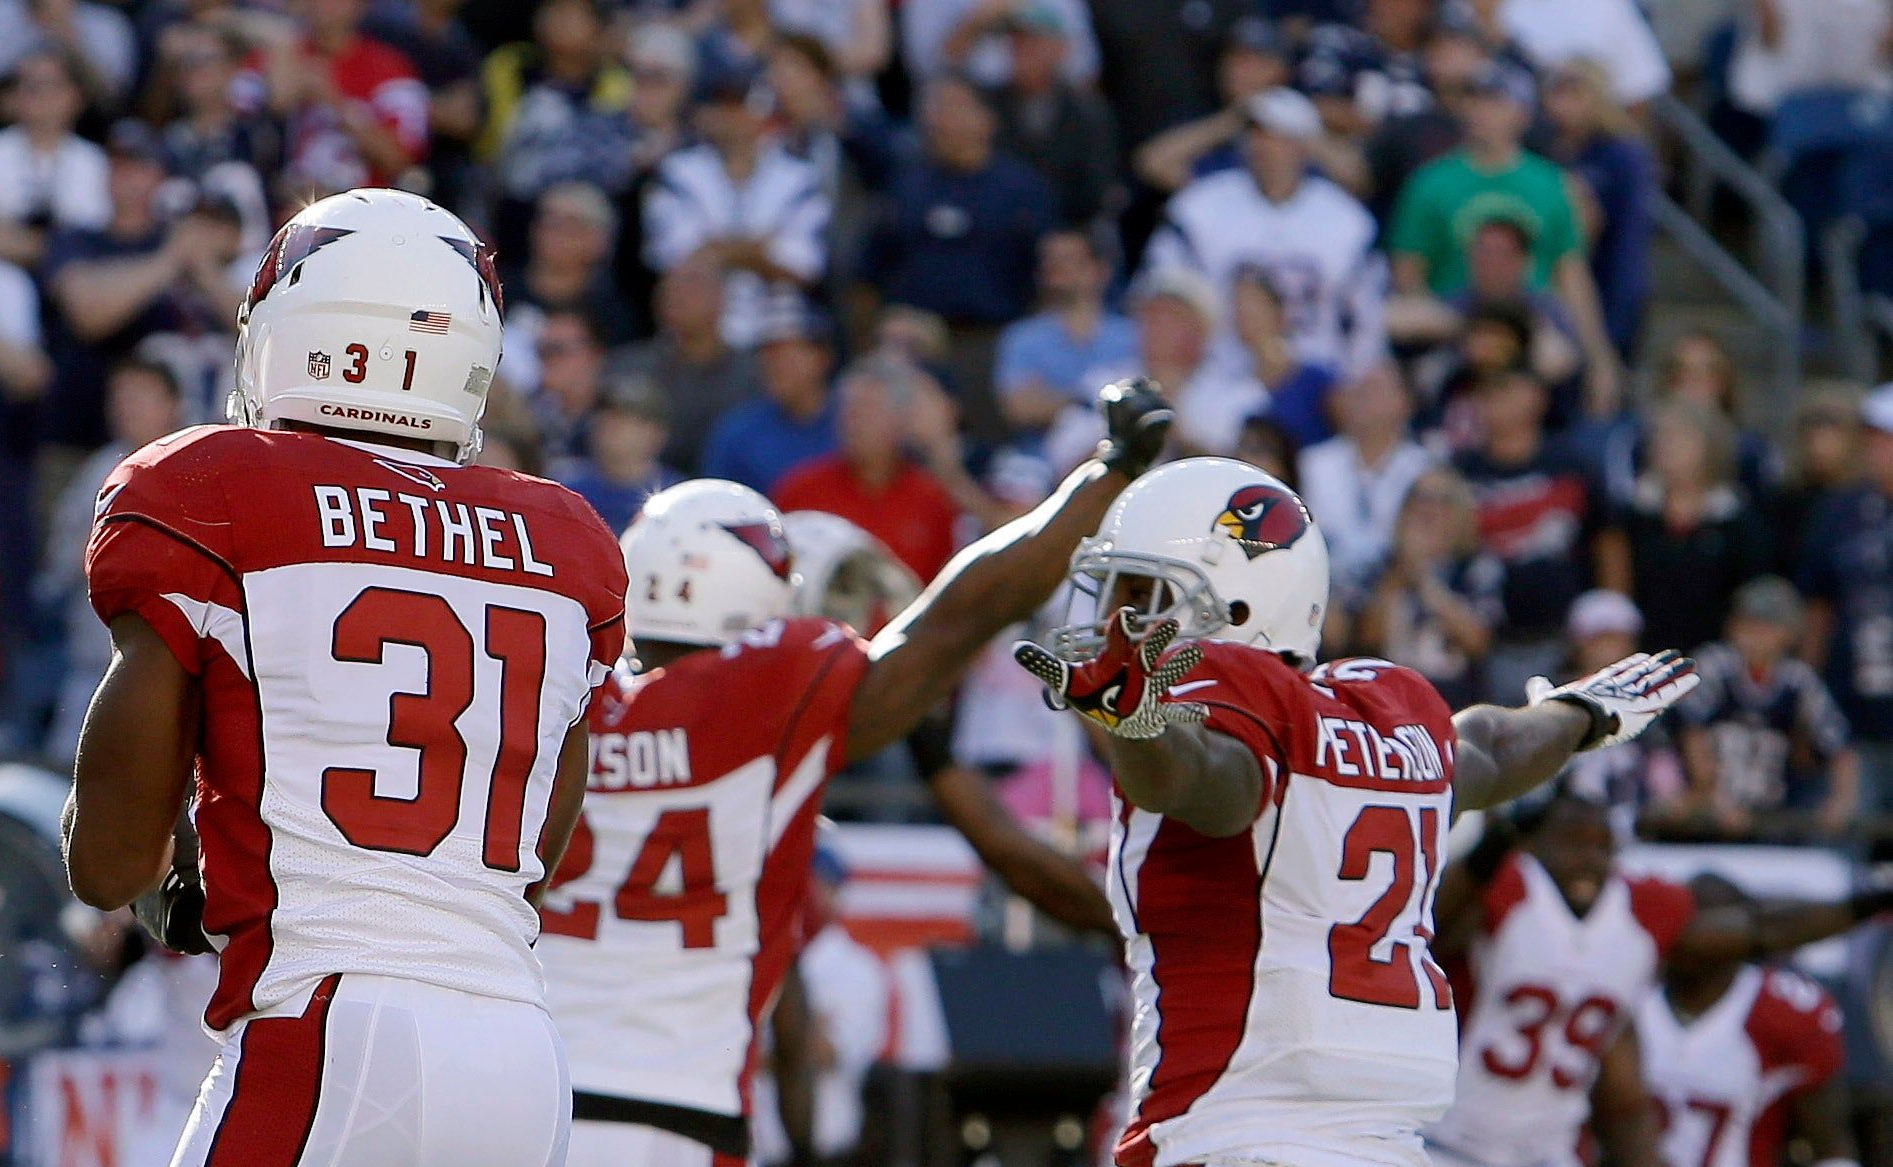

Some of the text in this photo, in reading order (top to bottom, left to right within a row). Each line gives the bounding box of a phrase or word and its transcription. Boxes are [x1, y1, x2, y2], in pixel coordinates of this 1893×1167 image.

[319, 403, 432, 430] CARDINALS
[313, 485, 555, 577] BETHEL
[320, 586, 547, 873] 31
[541, 807, 728, 949] 24
[1480, 983, 1618, 1090] 39
